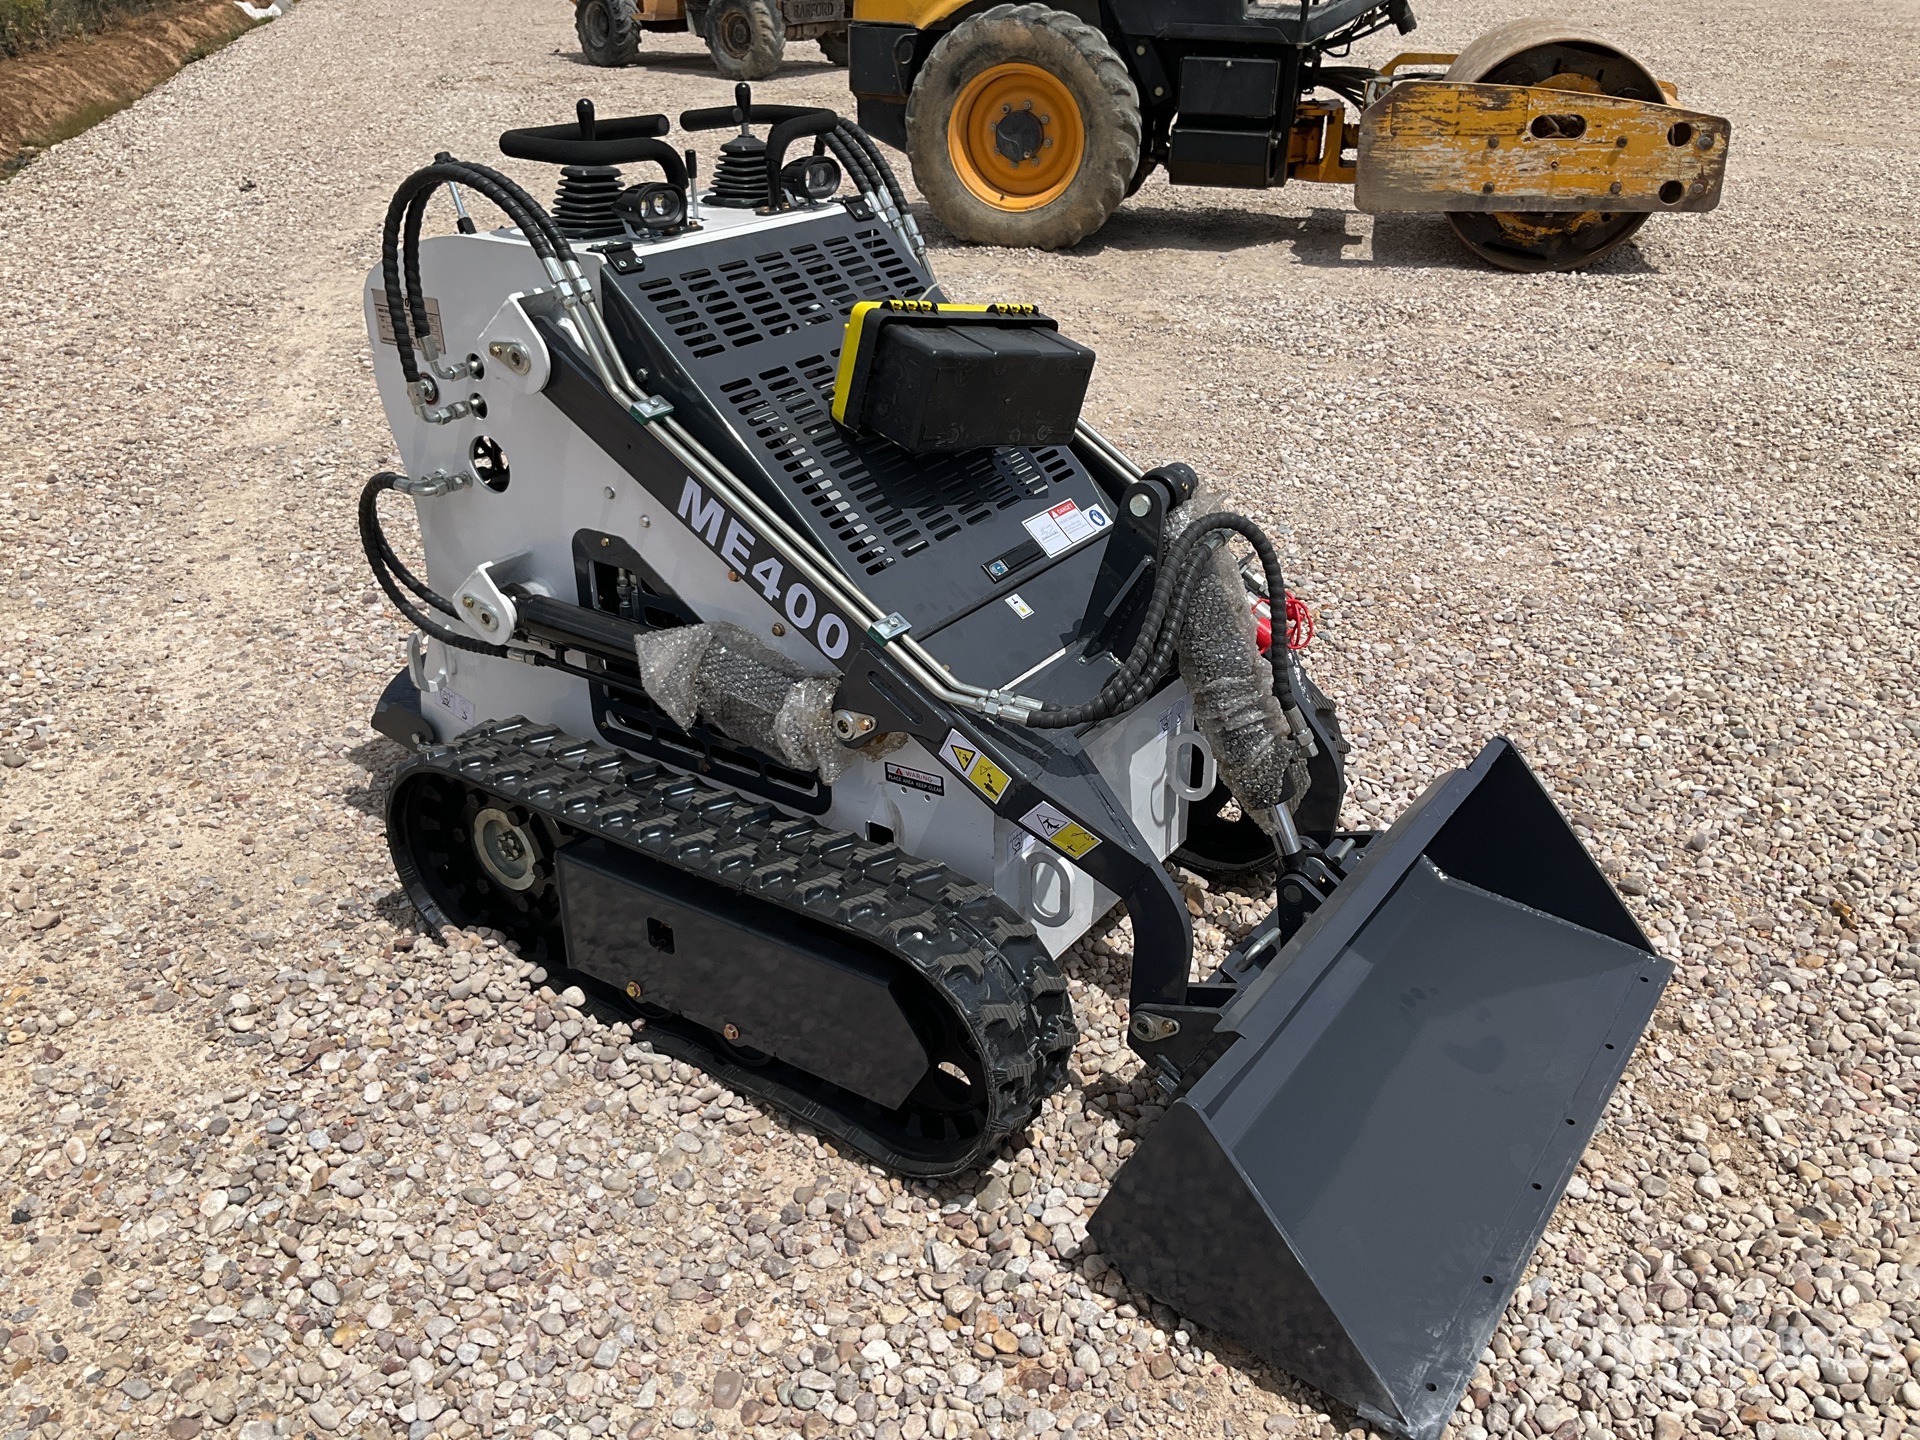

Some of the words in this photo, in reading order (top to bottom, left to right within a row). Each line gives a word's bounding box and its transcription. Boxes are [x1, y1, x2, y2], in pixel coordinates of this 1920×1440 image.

[677, 475, 849, 660] ME400
[903, 778, 915, 786] AREA
[905, 770, 933, 783] WARING
